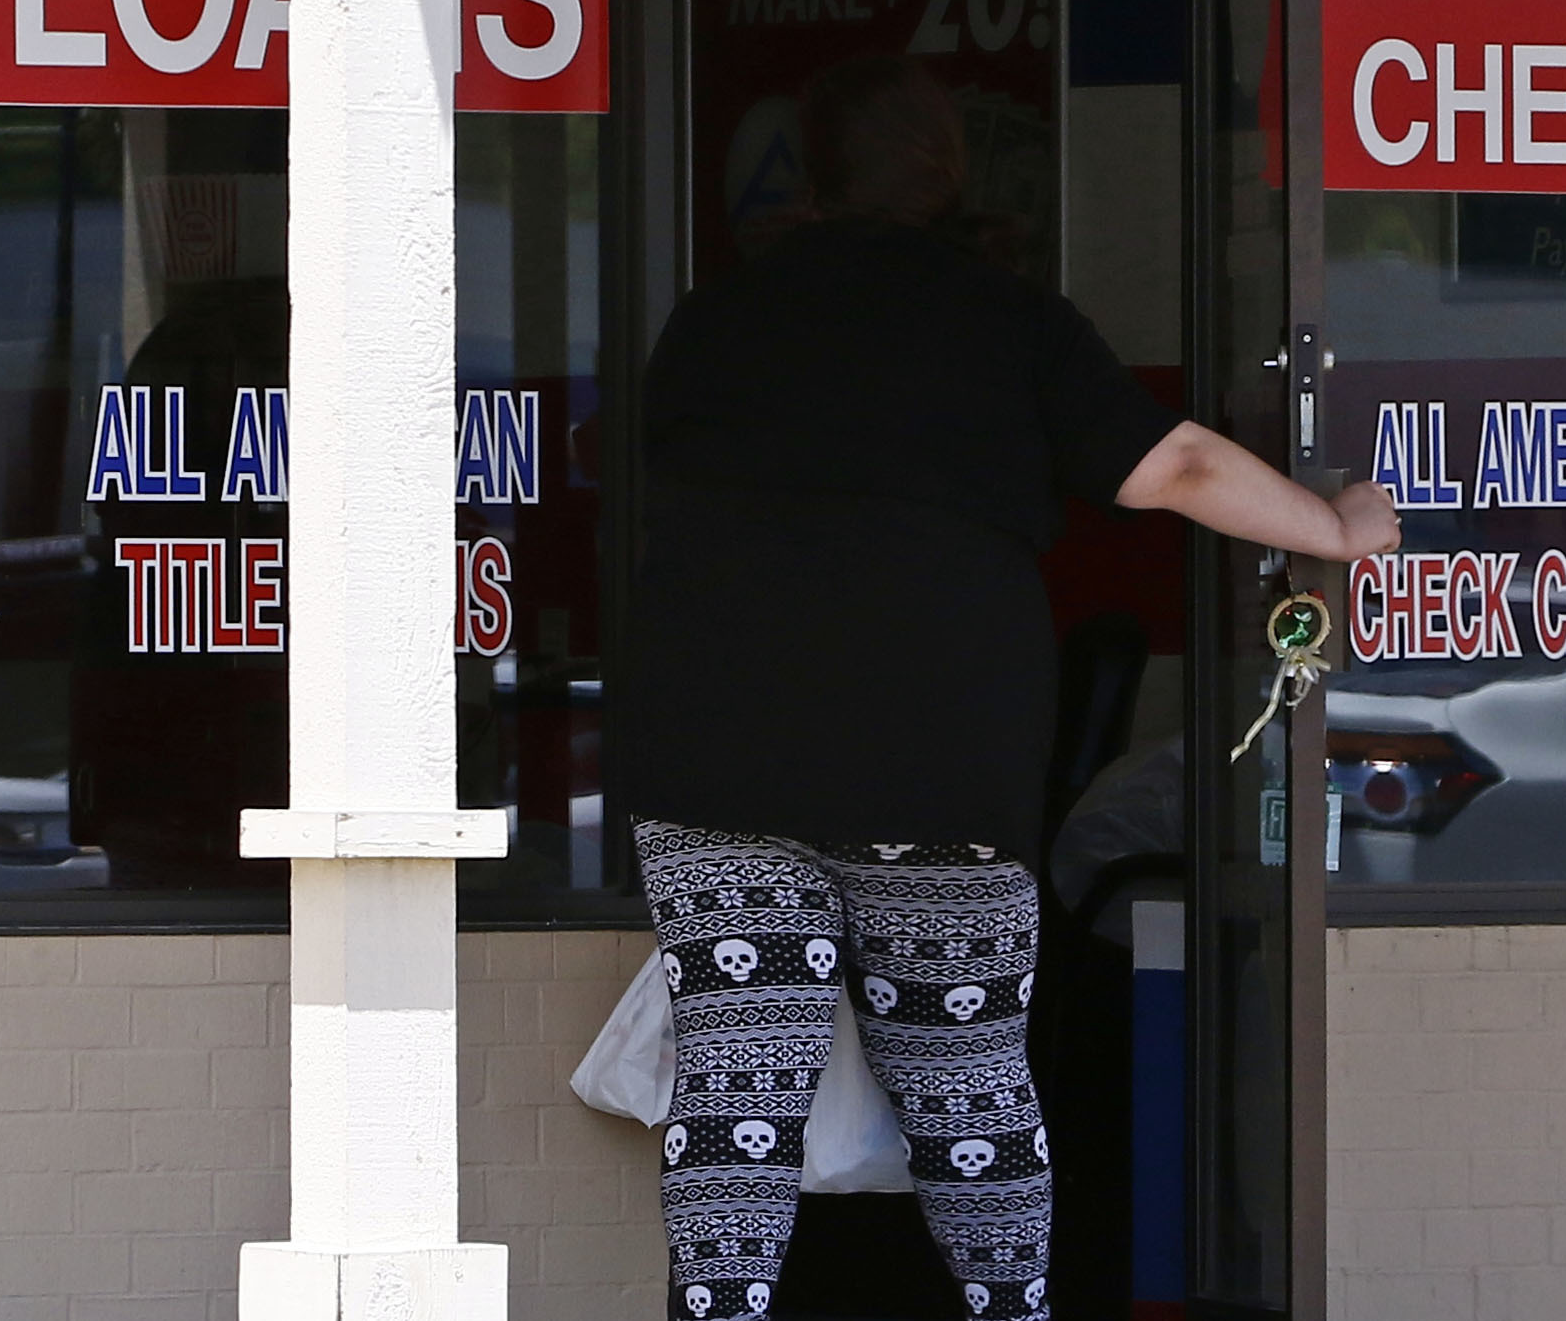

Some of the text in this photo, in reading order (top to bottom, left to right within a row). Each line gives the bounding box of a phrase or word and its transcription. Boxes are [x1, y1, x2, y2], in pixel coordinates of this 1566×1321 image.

[86, 385, 206, 502] ALL
[1372, 401, 1463, 510] ALL
[115, 538, 283, 653] TITLE
[1348, 550, 1522, 663] CHECK
